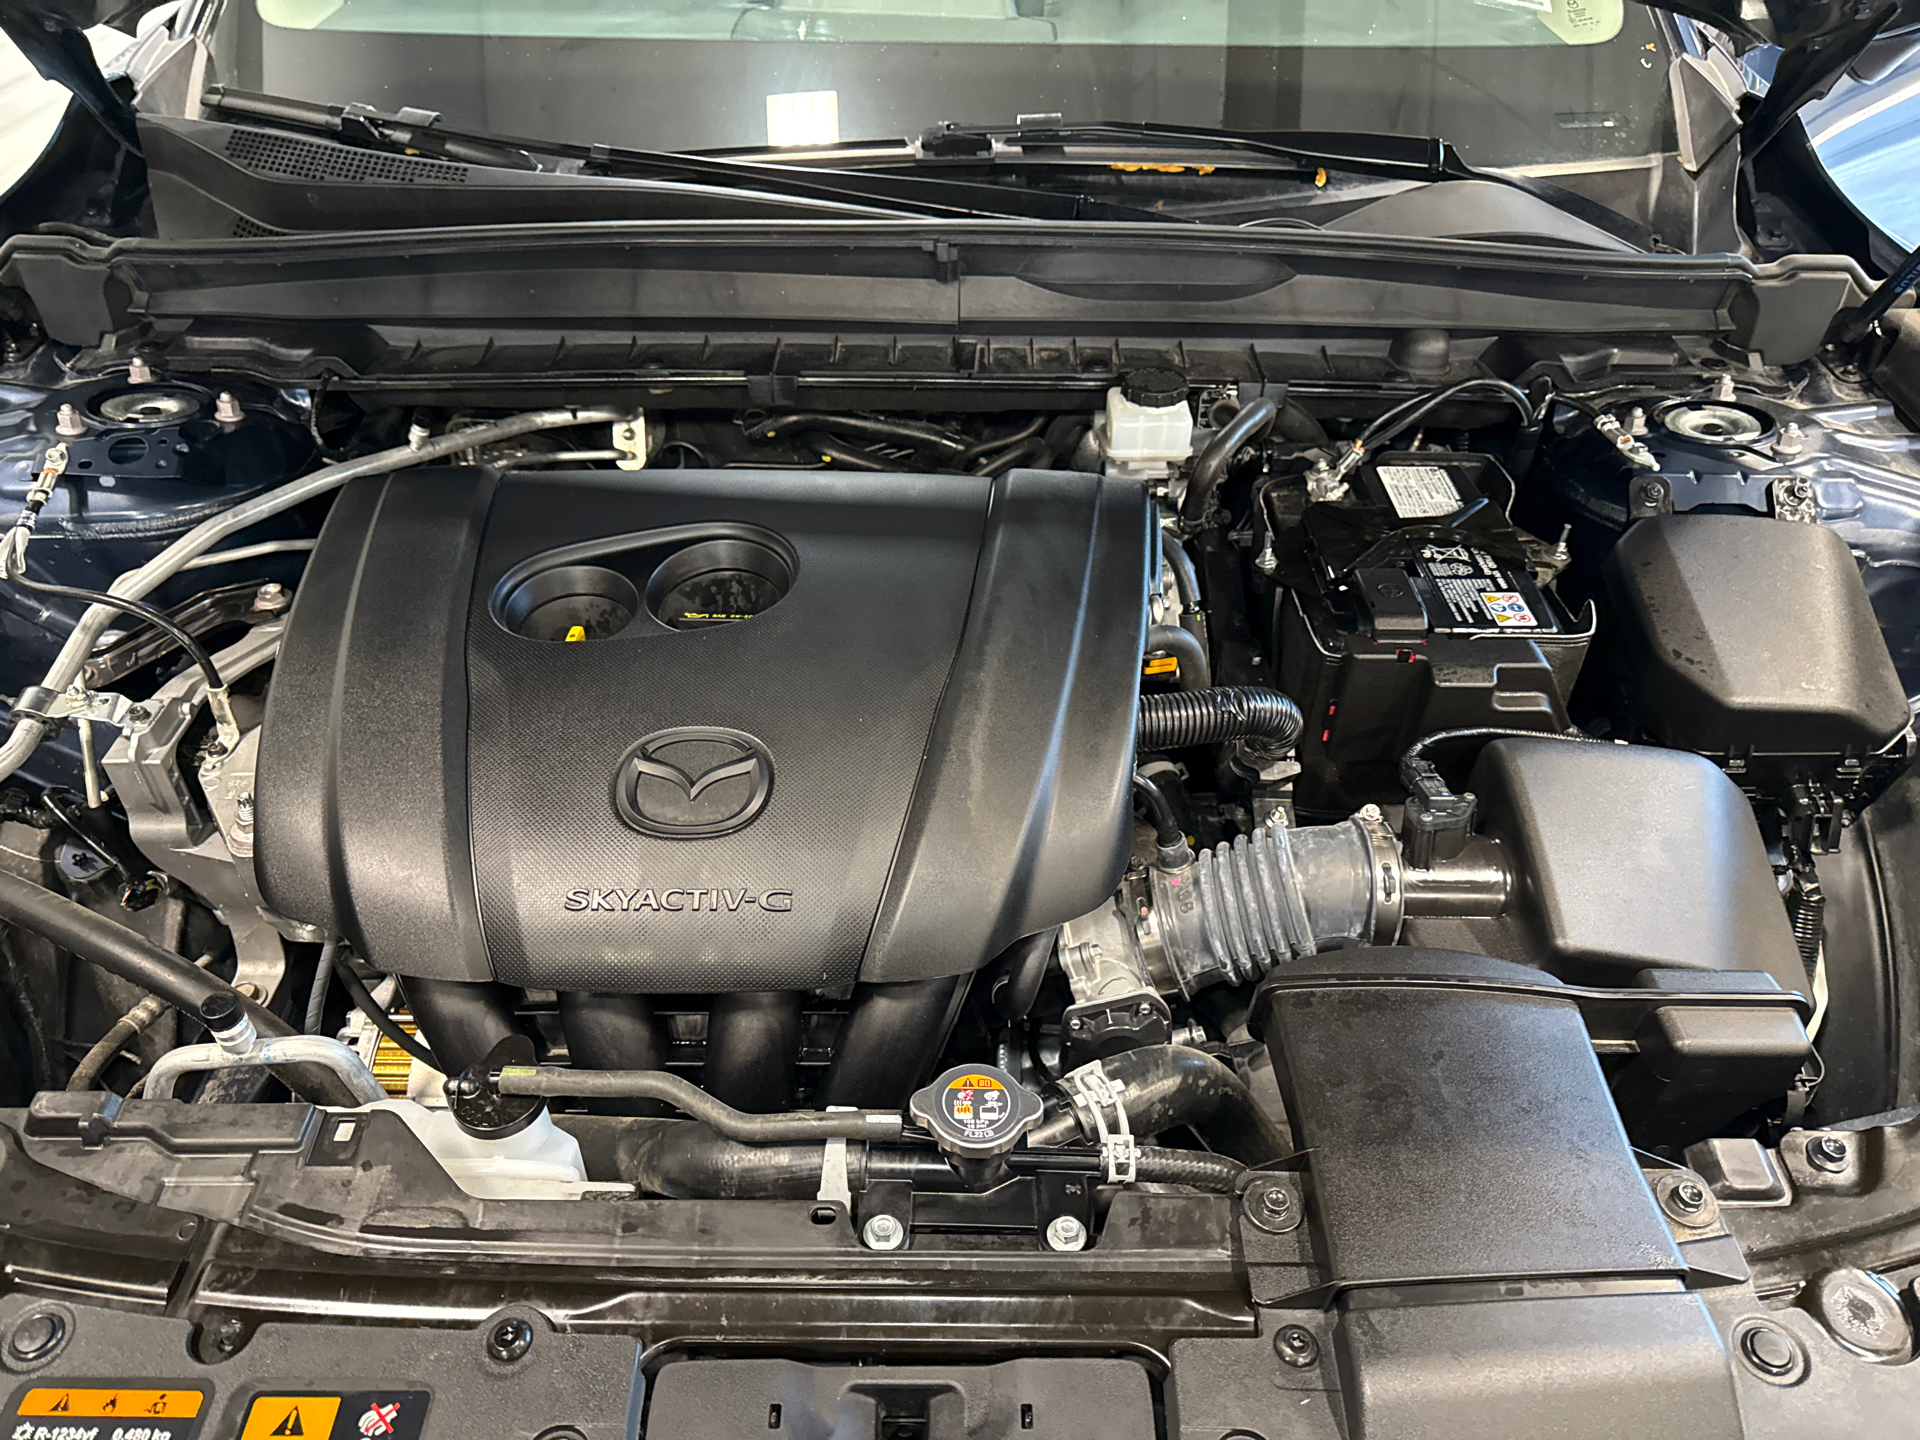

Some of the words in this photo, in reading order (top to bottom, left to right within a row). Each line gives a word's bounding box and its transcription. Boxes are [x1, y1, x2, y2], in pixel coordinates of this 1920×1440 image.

[564, 888, 793, 912] SKYACTIV-G
[964, 1130, 984, 1138] FL22
[34, 1426, 99, 1440] R-1234yf
